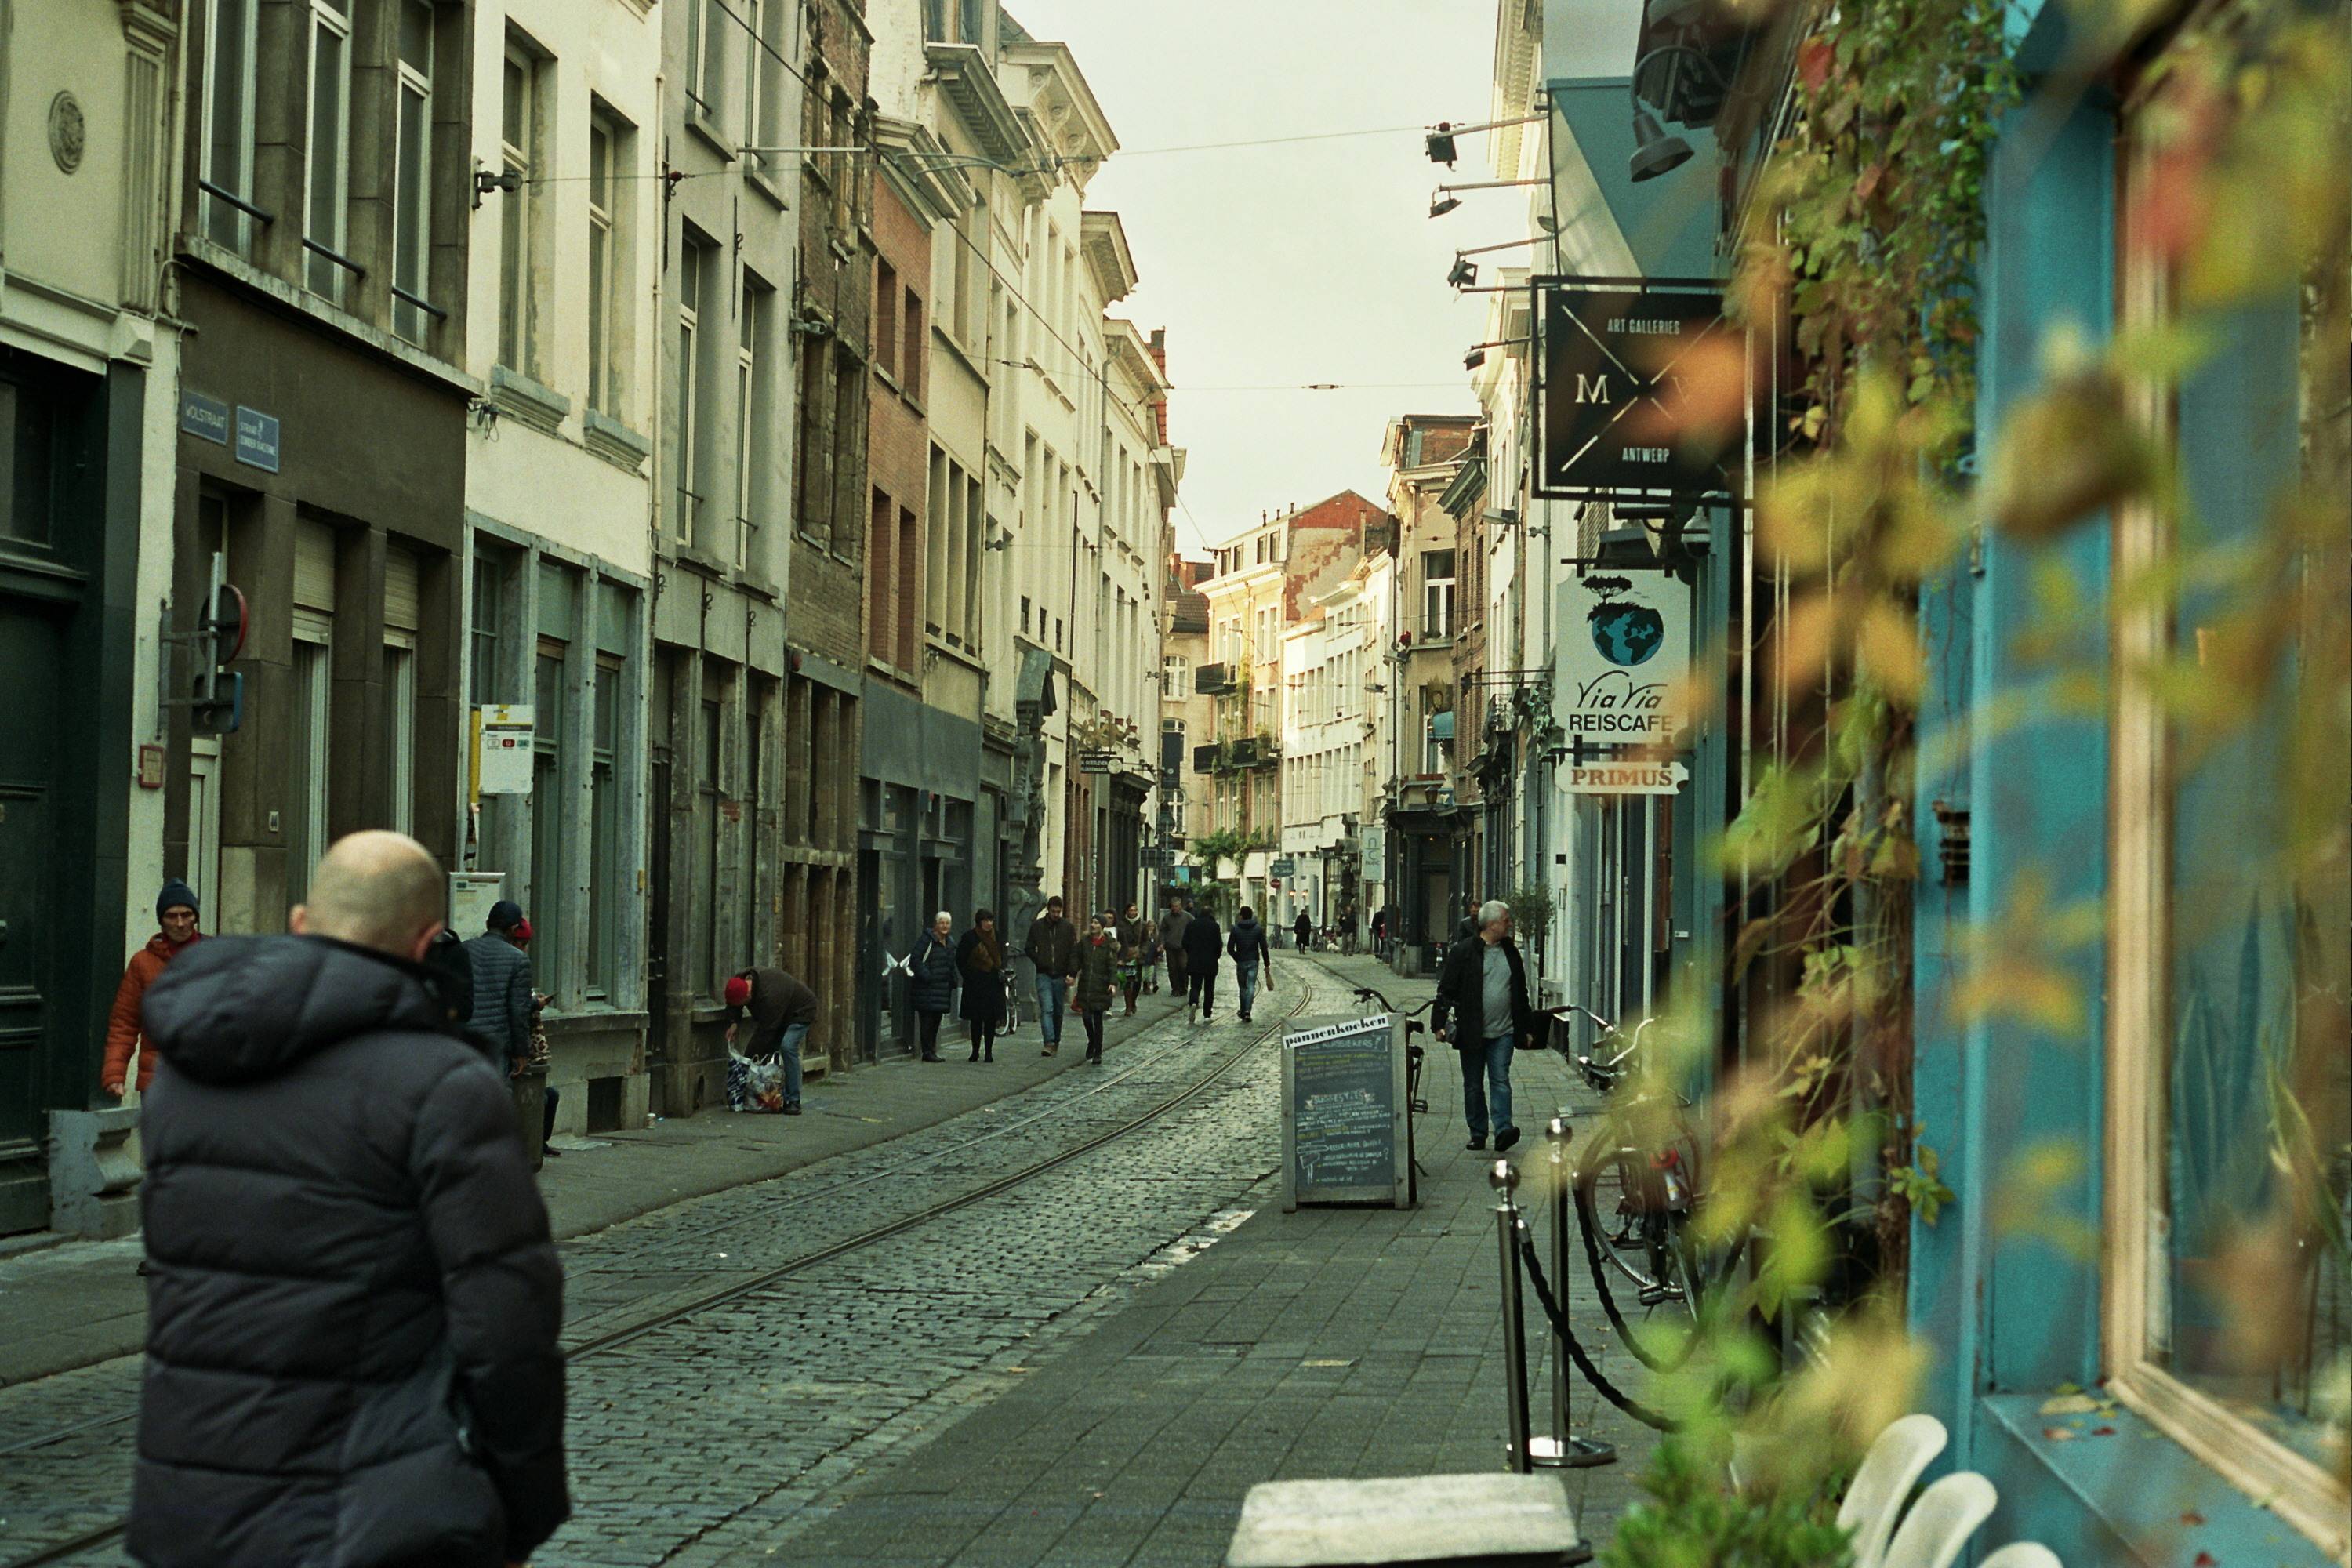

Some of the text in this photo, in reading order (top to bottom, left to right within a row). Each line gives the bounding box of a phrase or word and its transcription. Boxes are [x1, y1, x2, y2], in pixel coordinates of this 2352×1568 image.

[1608, 318, 1680, 335] ART GALLERIES
[1575, 373, 1610, 404] M
[1622, 448, 1670, 463] ANTWERP
[1569, 713, 1673, 732] REISCAFE
[1571, 768, 1673, 787] PRIMUS
[1285, 1018, 1386, 1049] pannenkoeken
